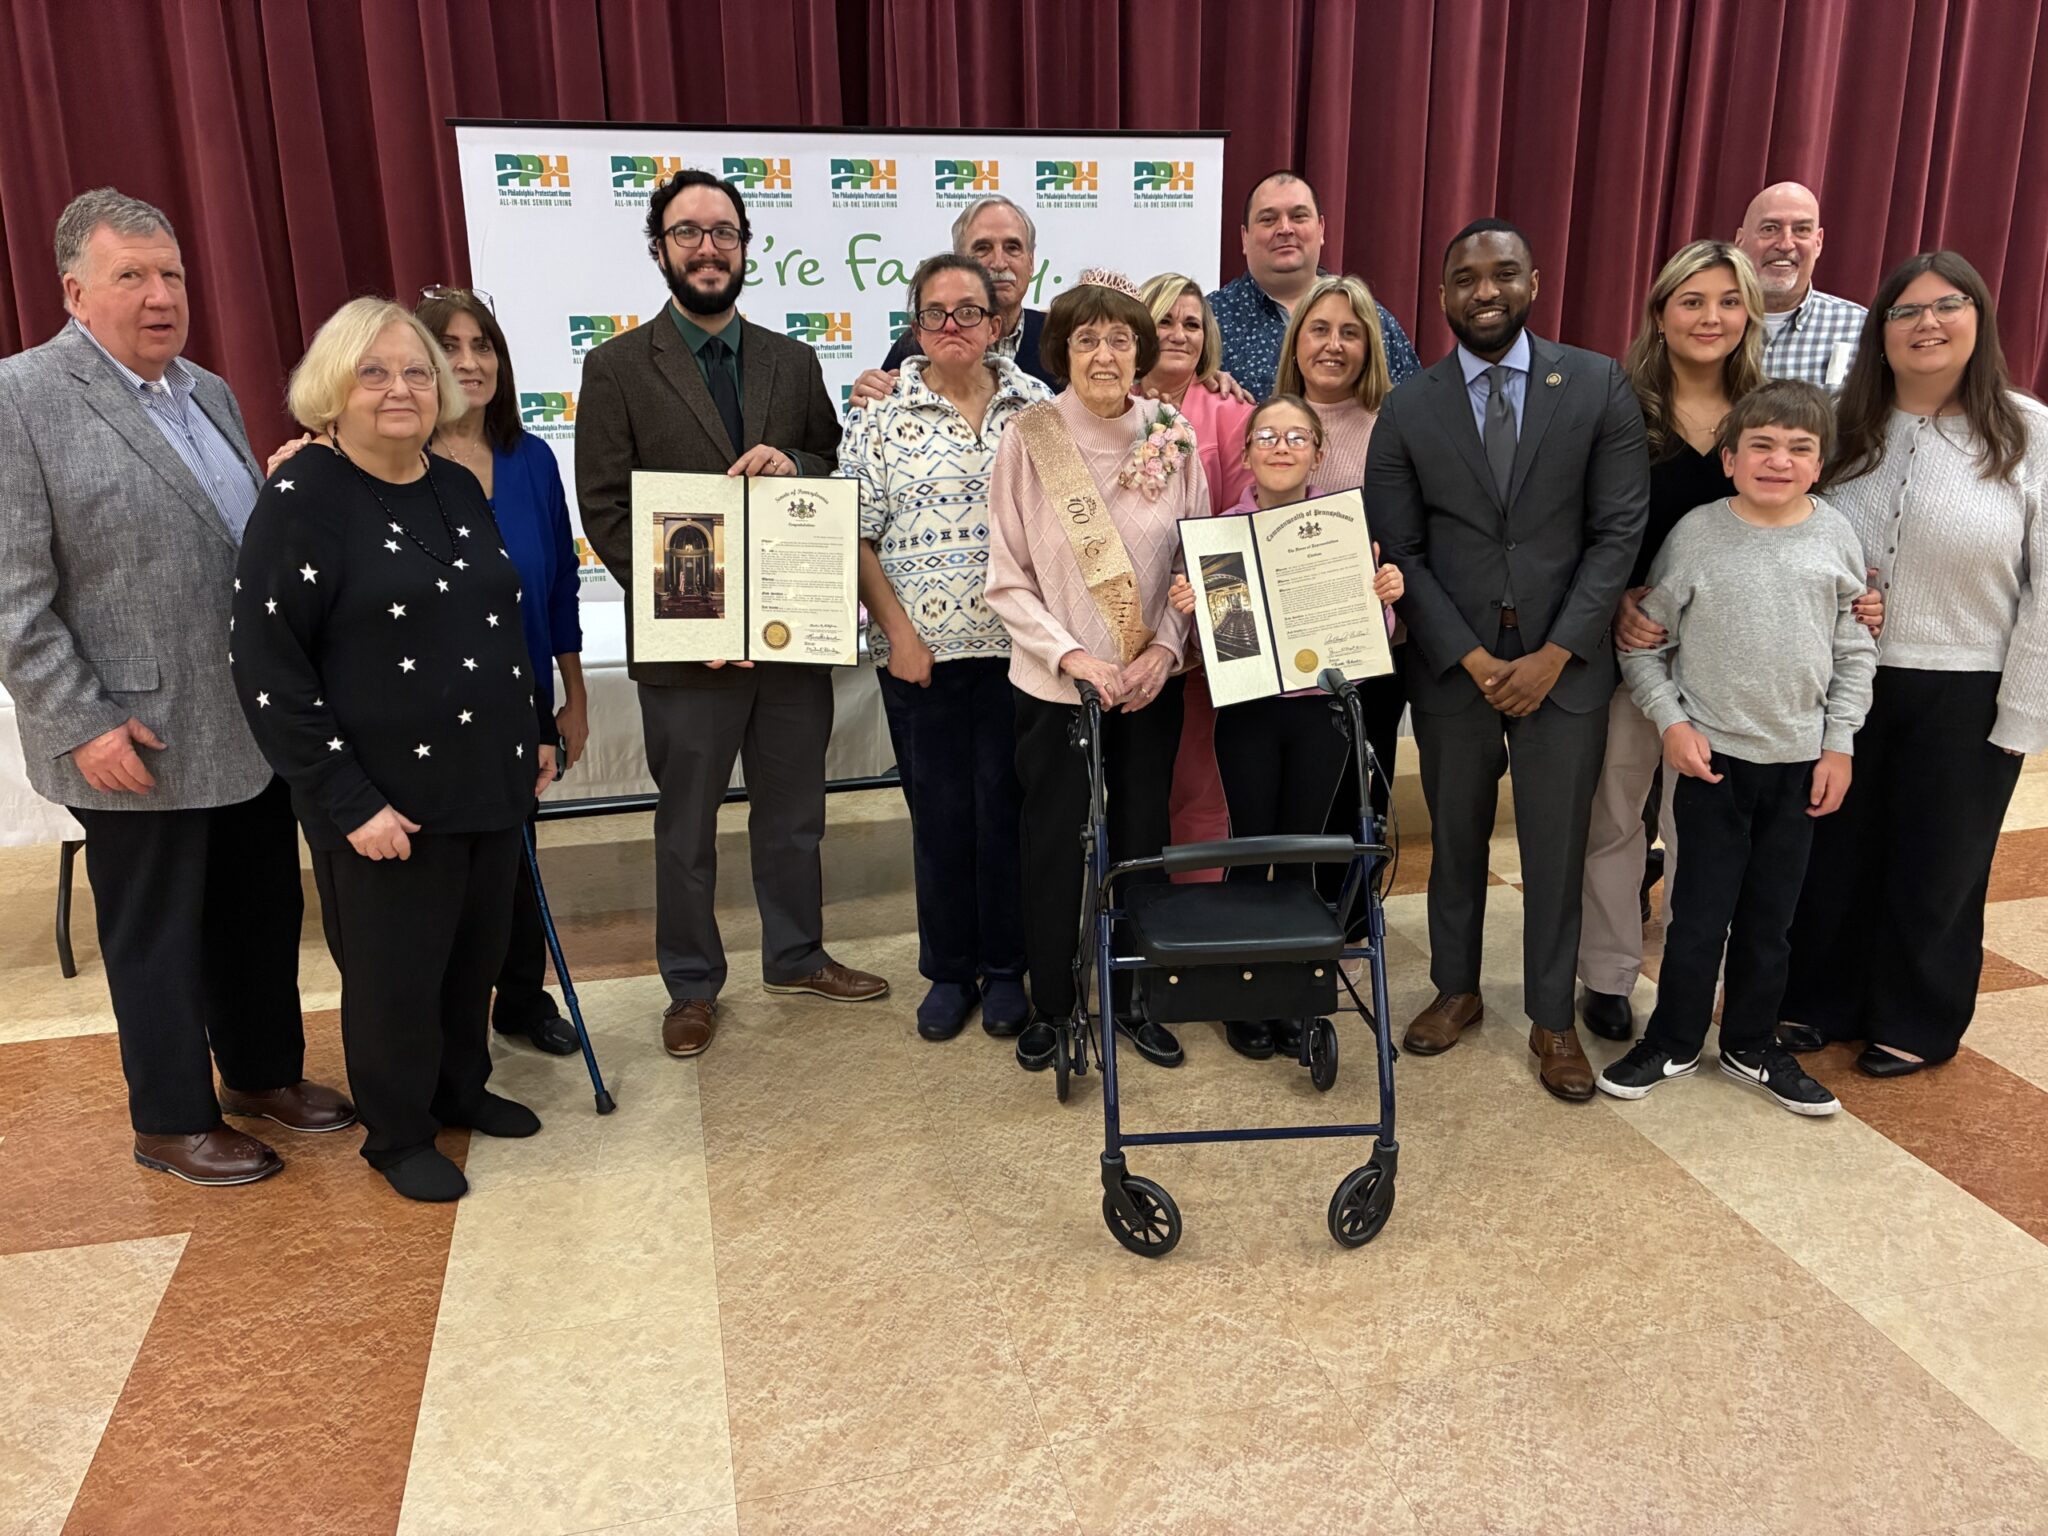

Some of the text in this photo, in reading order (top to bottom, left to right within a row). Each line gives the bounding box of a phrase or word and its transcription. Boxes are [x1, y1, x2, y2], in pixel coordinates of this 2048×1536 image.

[495, 154, 570, 187] PPH
[611, 156, 682, 188] PPH
[723, 158, 791, 189] PPH
[830, 159, 896, 190] PPH
[935, 160, 999, 190] PPH
[1036, 161, 1098, 190] PPH
[1134, 162, 1194, 190] PPH
[508, 189, 534, 197] Philadelphia
[532, 198, 552, 206] SENIOR
[742, 235, 824, 286] e're
[786, 312, 852, 342] PPH
[1266, 512, 1304, 542] Commonwealth
